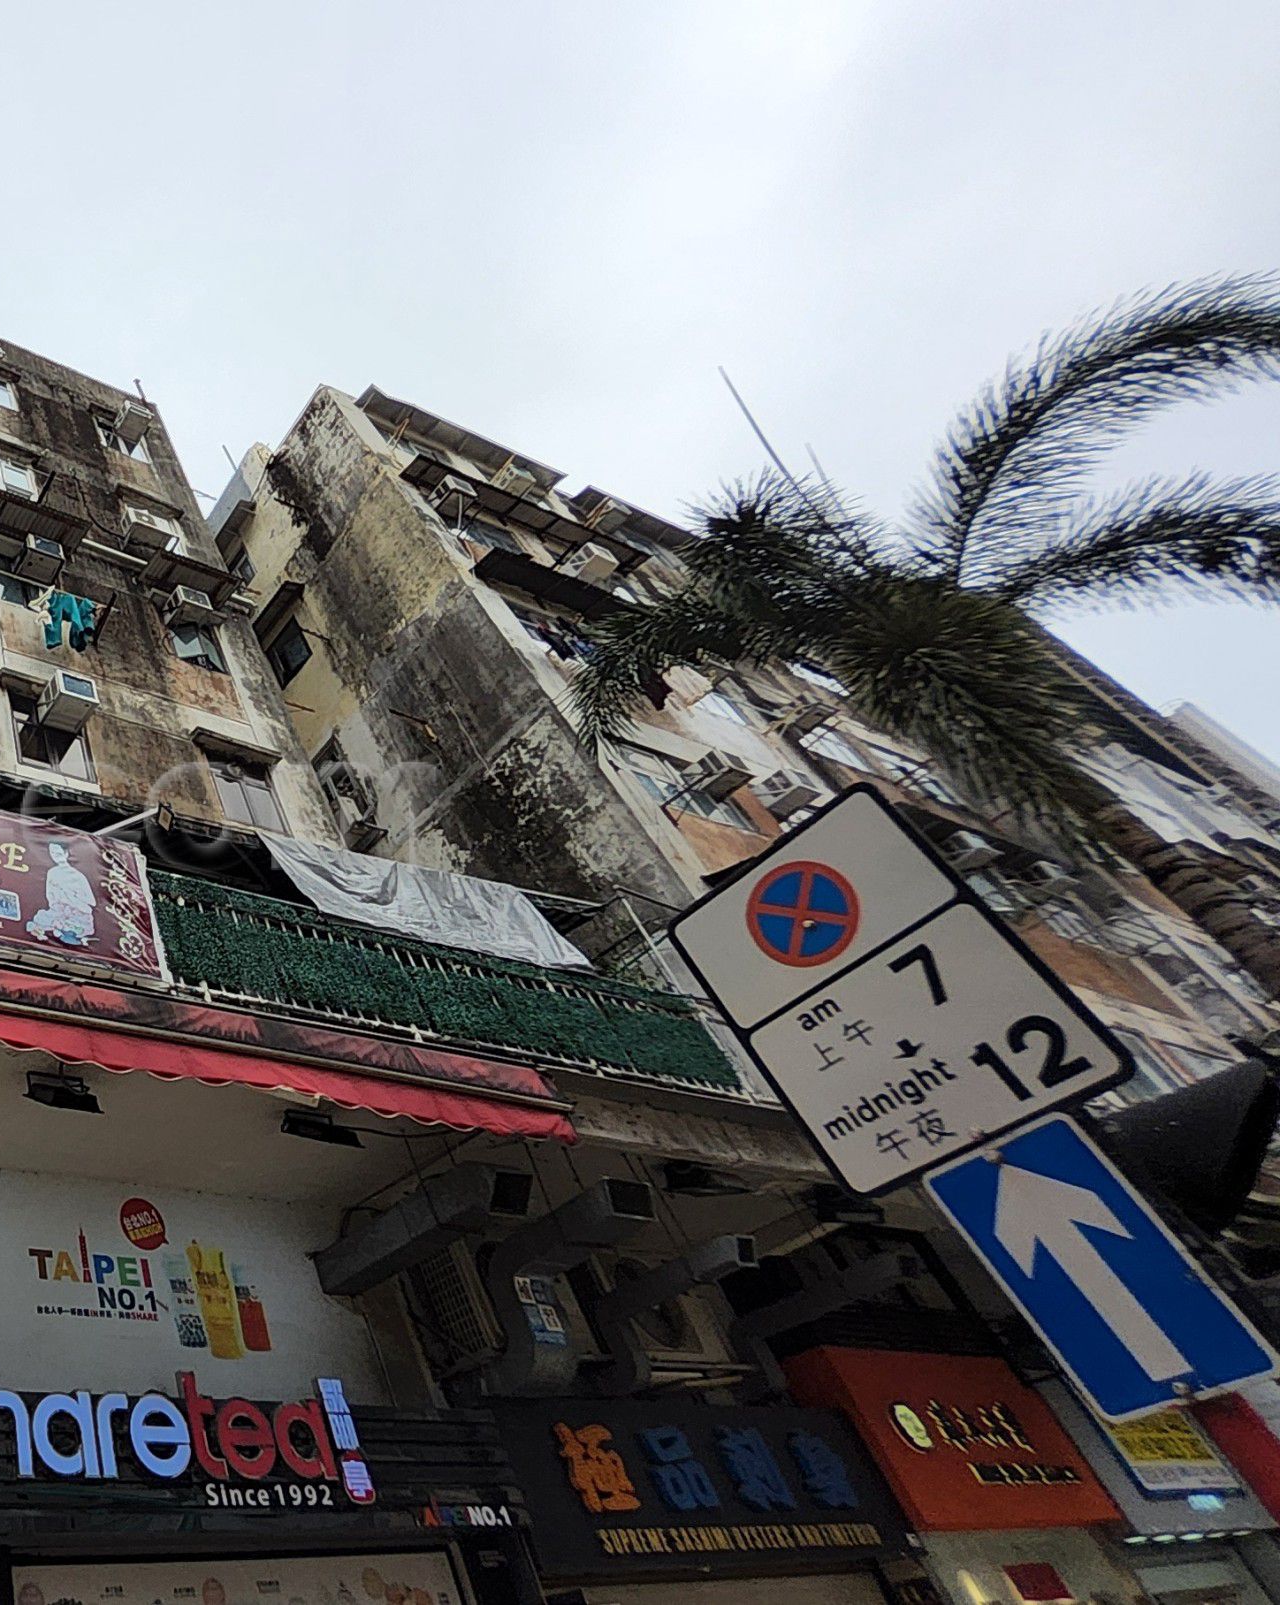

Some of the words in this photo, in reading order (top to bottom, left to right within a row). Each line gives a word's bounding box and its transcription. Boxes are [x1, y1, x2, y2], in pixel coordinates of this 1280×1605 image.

[796, 998, 843, 1031] am
[887, 944, 948, 1006] 7
[813, 1019, 874, 1072] 上午
[823, 1058, 958, 1141] midnight
[969, 1015, 1094, 1102] 12
[875, 1108, 958, 1160] 午夜
[29, 1226, 153, 1288] TAIPEI
[98, 1286, 157, 1312] NO.1
[206, 1483, 270, 1507] Since
[276, 1484, 334, 1507] 1992
[465, 1505, 513, 1527] NO.1
[597, 1527, 672, 1555] SUPREME
